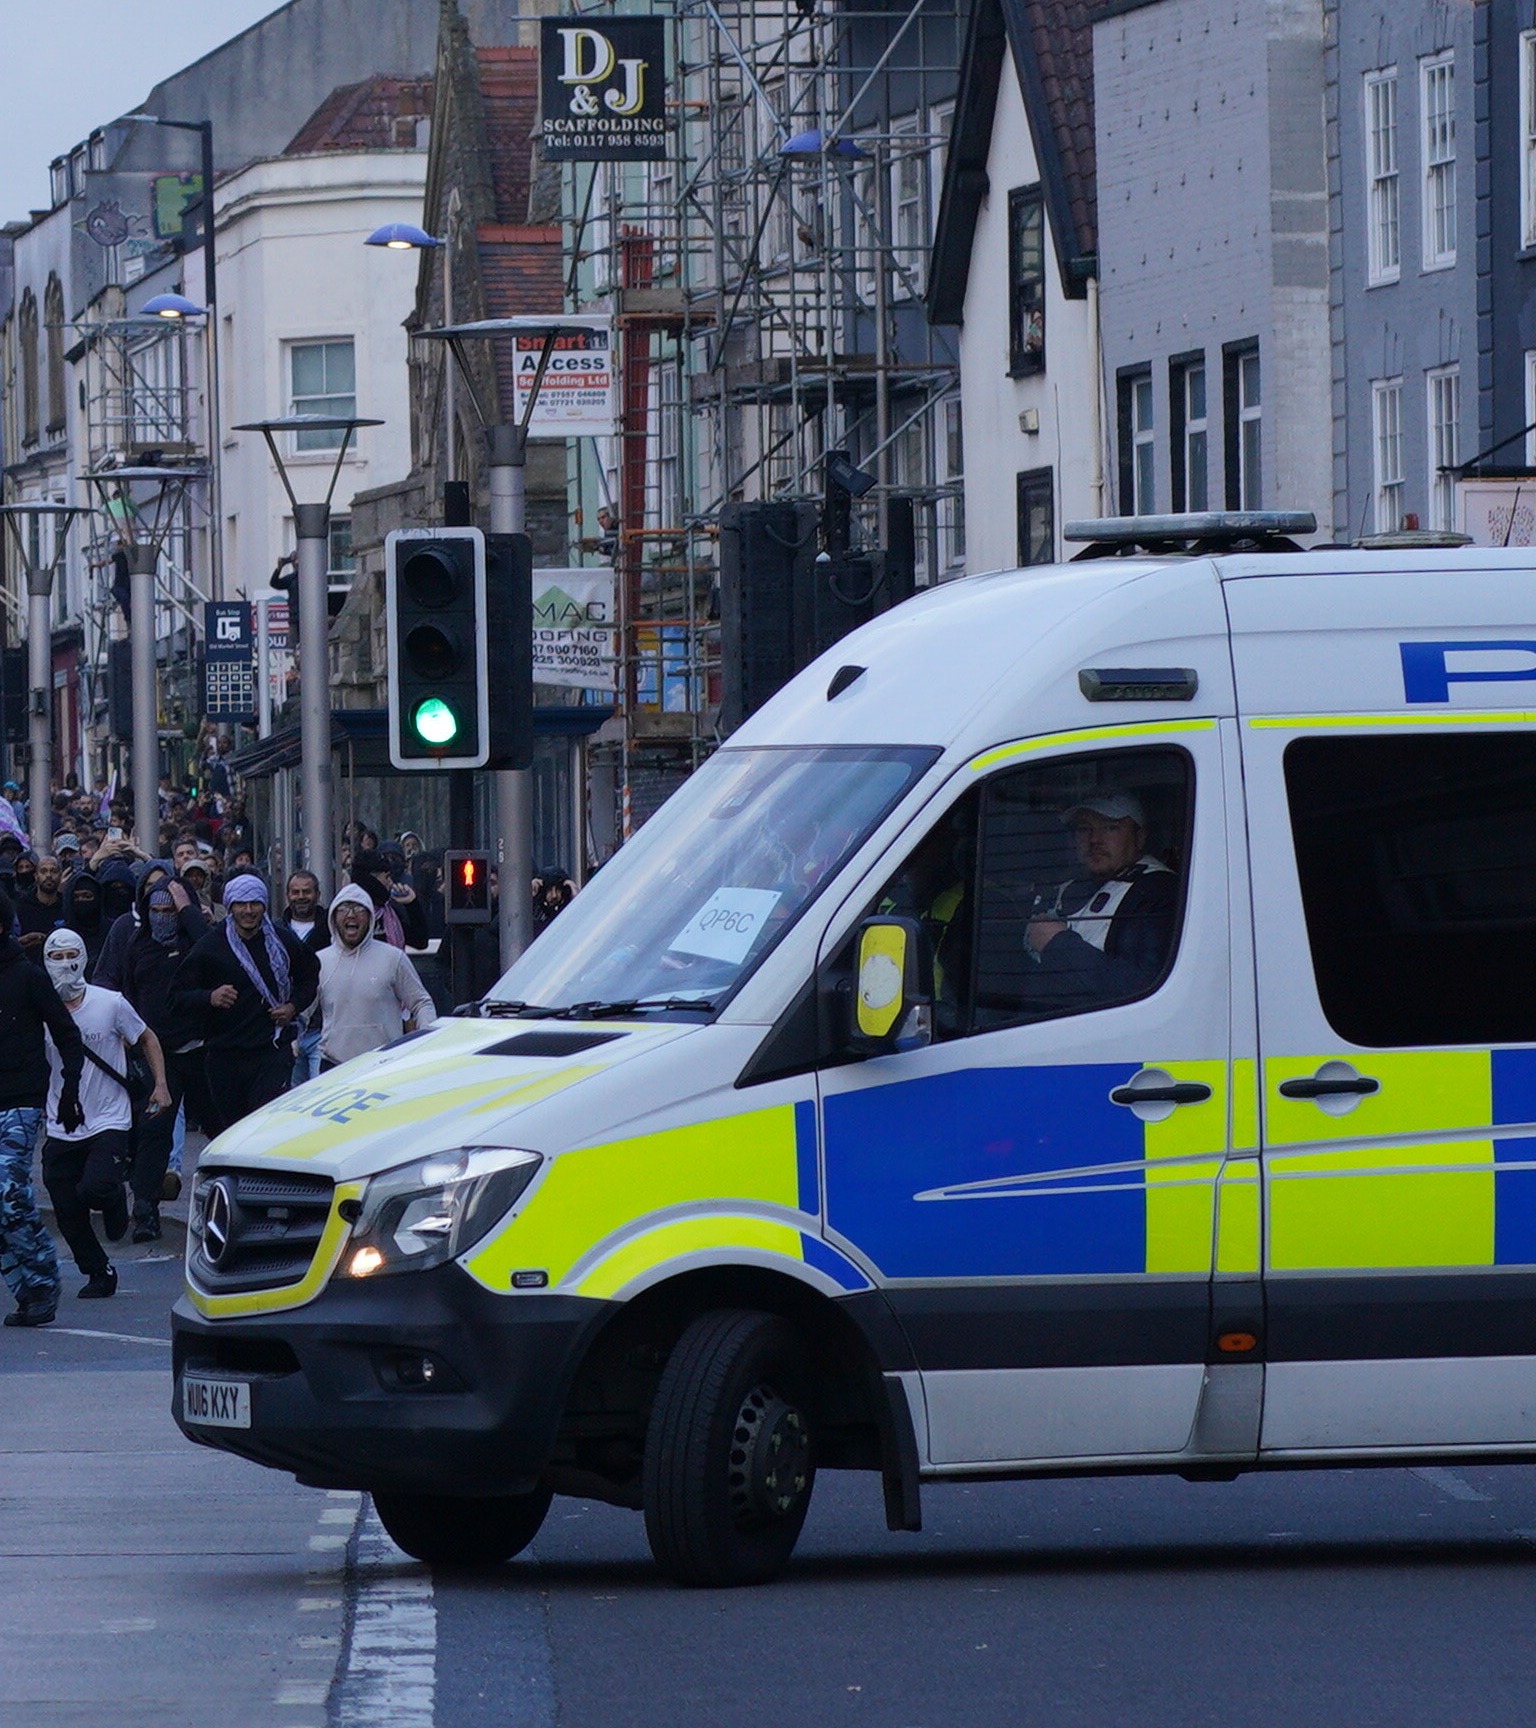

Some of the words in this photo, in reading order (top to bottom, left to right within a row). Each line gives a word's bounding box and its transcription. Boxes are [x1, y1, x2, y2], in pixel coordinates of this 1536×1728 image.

[557, 28, 615, 84] D
[569, 85, 599, 116] &
[604, 59, 649, 116] J
[544, 119, 664, 132] SCAFFOLDING
[545, 134, 571, 147] Tel:
[574, 135, 604, 147] 0117
[608, 135, 631, 147] 958
[634, 134, 665, 147] 8593
[521, 355, 605, 371] Acess
[588, 375, 607, 386] Ltd
[210, 1384, 239, 1420] KXY
